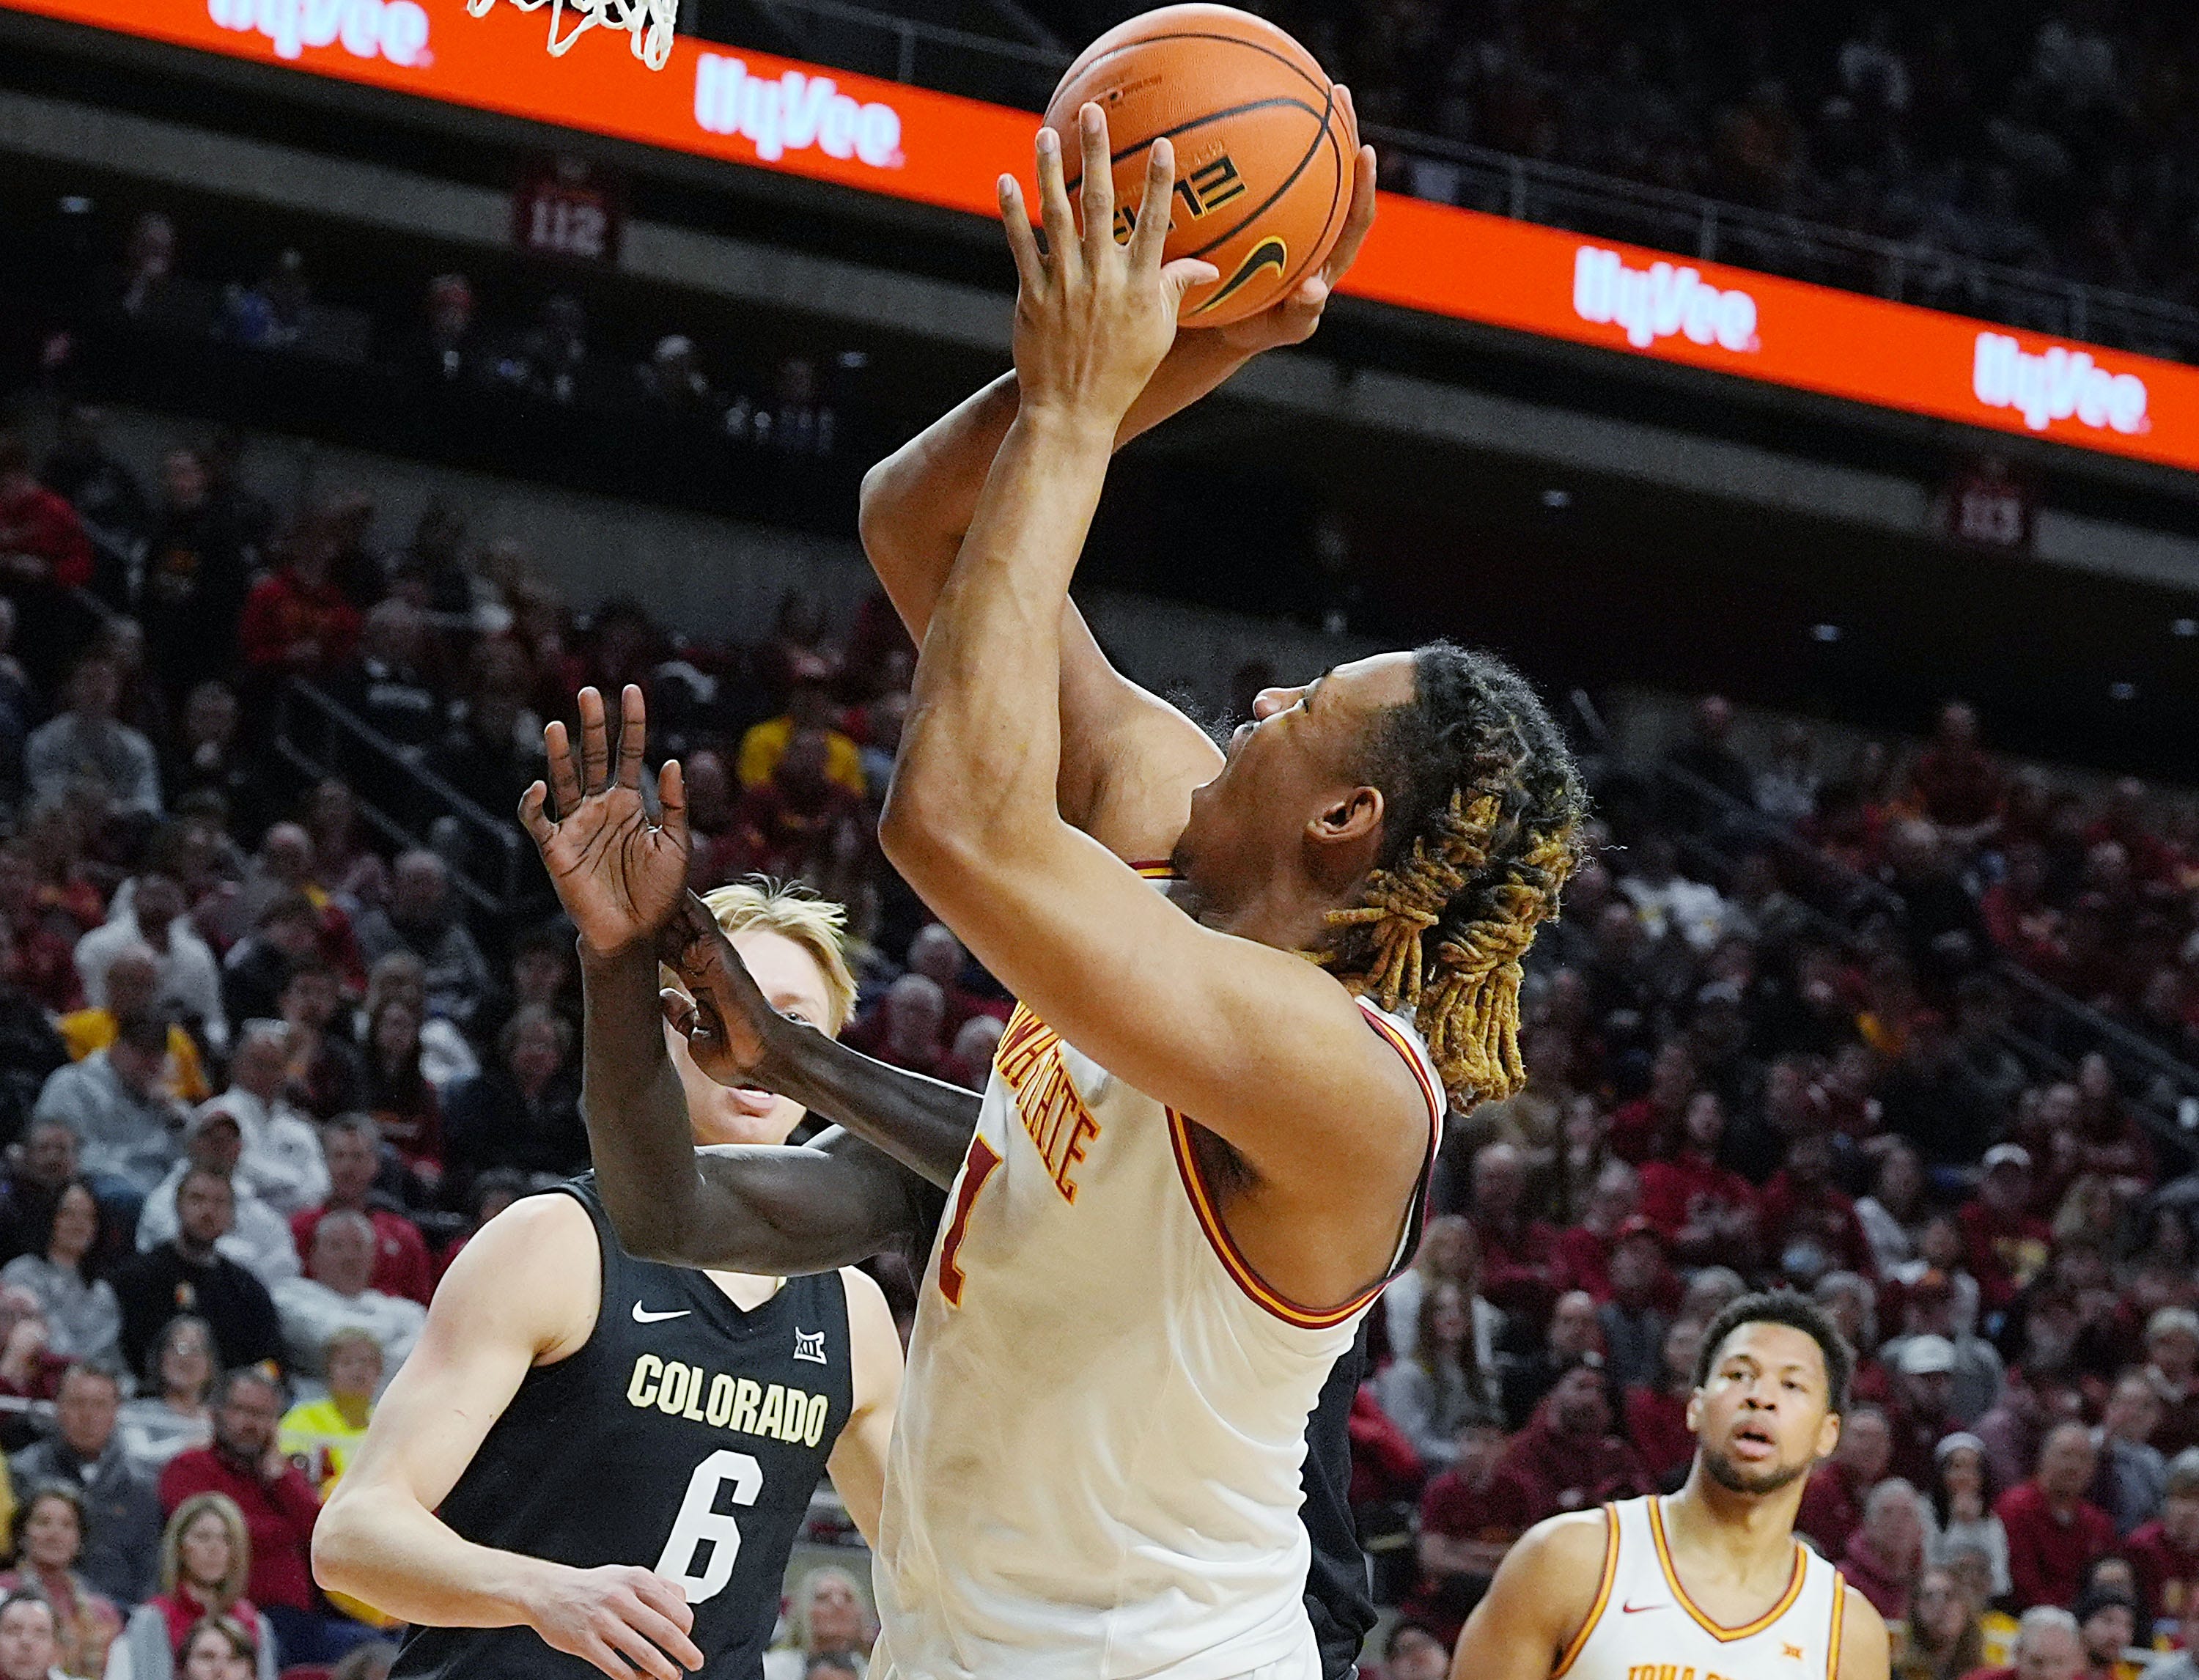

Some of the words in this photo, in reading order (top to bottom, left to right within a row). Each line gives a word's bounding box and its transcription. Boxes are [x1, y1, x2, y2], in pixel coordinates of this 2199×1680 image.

[531, 197, 607, 256] 112
[939, 1132, 1003, 1309] 1
[627, 1353, 828, 1448] COLORADO
[654, 1449, 764, 1604] 6
